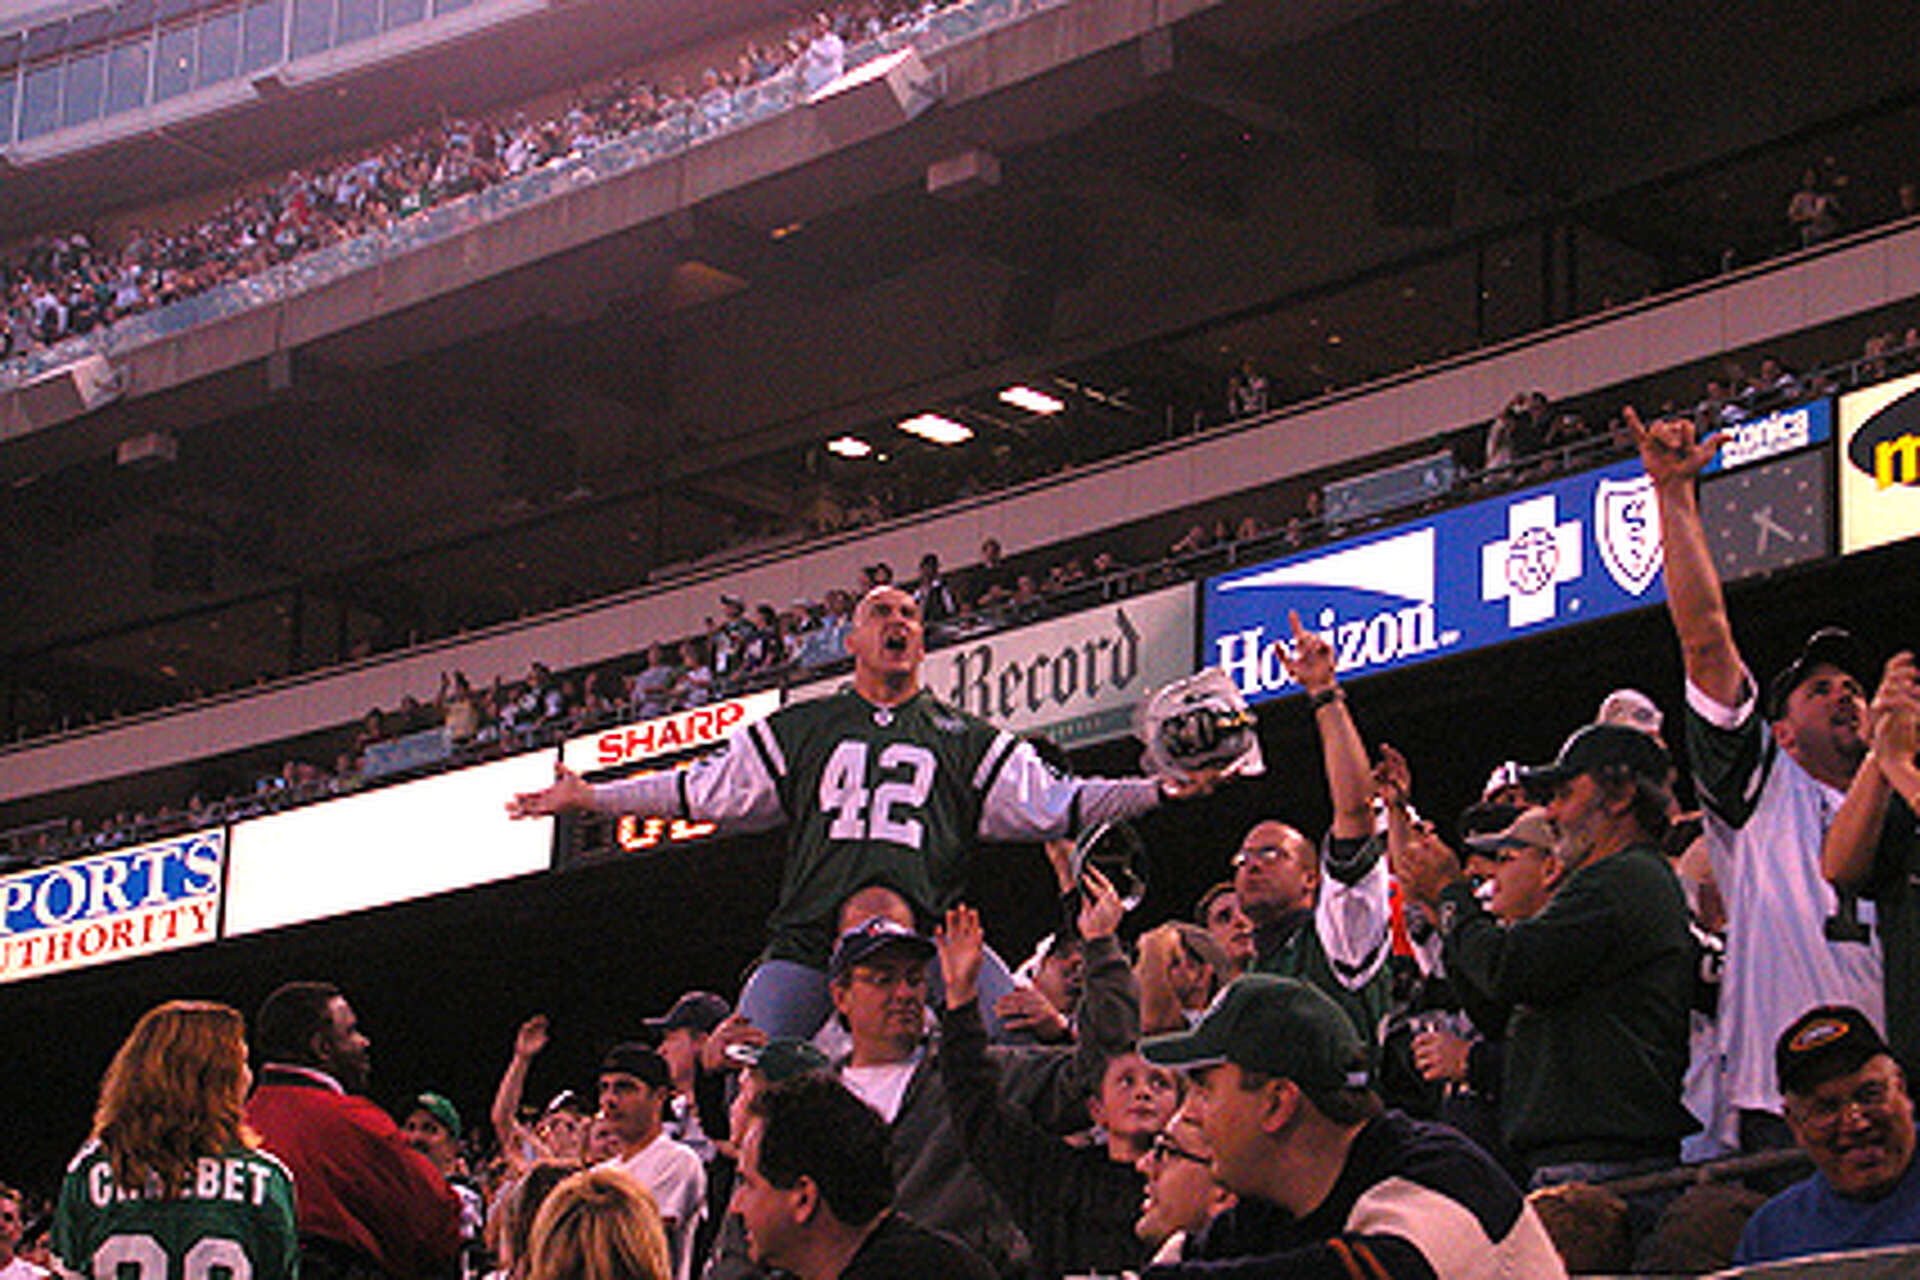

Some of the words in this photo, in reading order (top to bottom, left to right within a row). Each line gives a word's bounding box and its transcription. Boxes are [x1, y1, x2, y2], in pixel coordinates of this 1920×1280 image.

[949, 608, 1140, 718] Record
[1216, 600, 1438, 696] Hoizon
[598, 703, 745, 763] SHARP
[819, 740, 937, 849] 42
[89, 1157, 271, 1208] CBET
